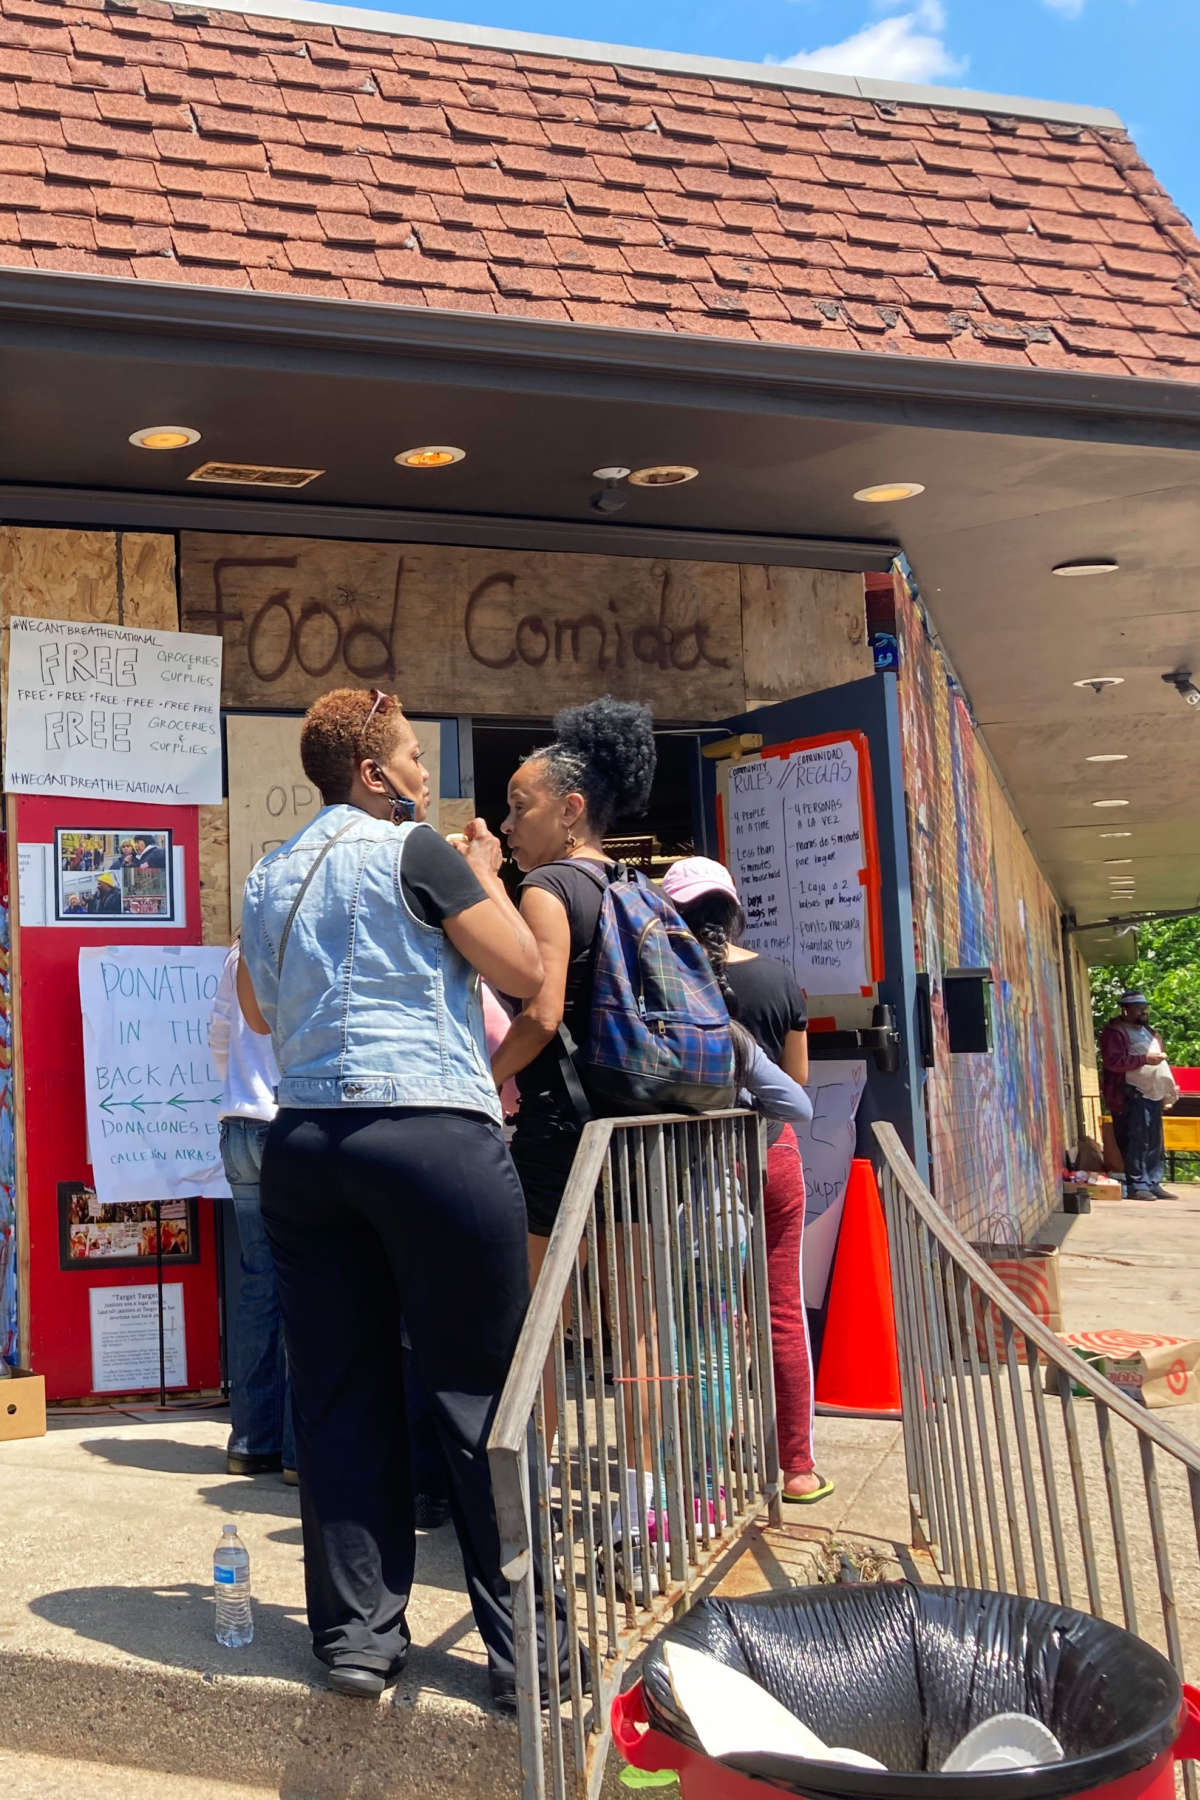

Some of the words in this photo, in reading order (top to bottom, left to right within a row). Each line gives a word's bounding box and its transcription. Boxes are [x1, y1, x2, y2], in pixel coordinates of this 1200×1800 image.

[184, 556, 404, 682] Food
[464, 570, 730, 672] Comida
[40, 642, 138, 687] FREE
[157, 650, 219, 668] GROCERIES
[161, 670, 214, 687] SUPPLIES
[18, 689, 47, 701] FREE
[57, 690, 86, 701] FREE
[95, 693, 119, 705] FREE
[126, 696, 153, 708] FREE
[165, 700, 188, 711] FREE
[193, 704, 214, 713] FREE
[45, 711, 131, 752] FREE
[148, 716, 216, 734] GROCERIES
[150, 742, 208, 755] SUPPLIES
[734, 772, 773, 794] RULES
[796, 759, 852, 789] REGLAS
[803, 799, 843, 815] PERSONAS
[101, 961, 217, 1004] DONATIO
[119, 1019, 142, 1046] IN
[96, 1065, 161, 1090] BACK
[168, 1061, 222, 1088] ALL
[102, 1119, 199, 1138] DONACIONES
